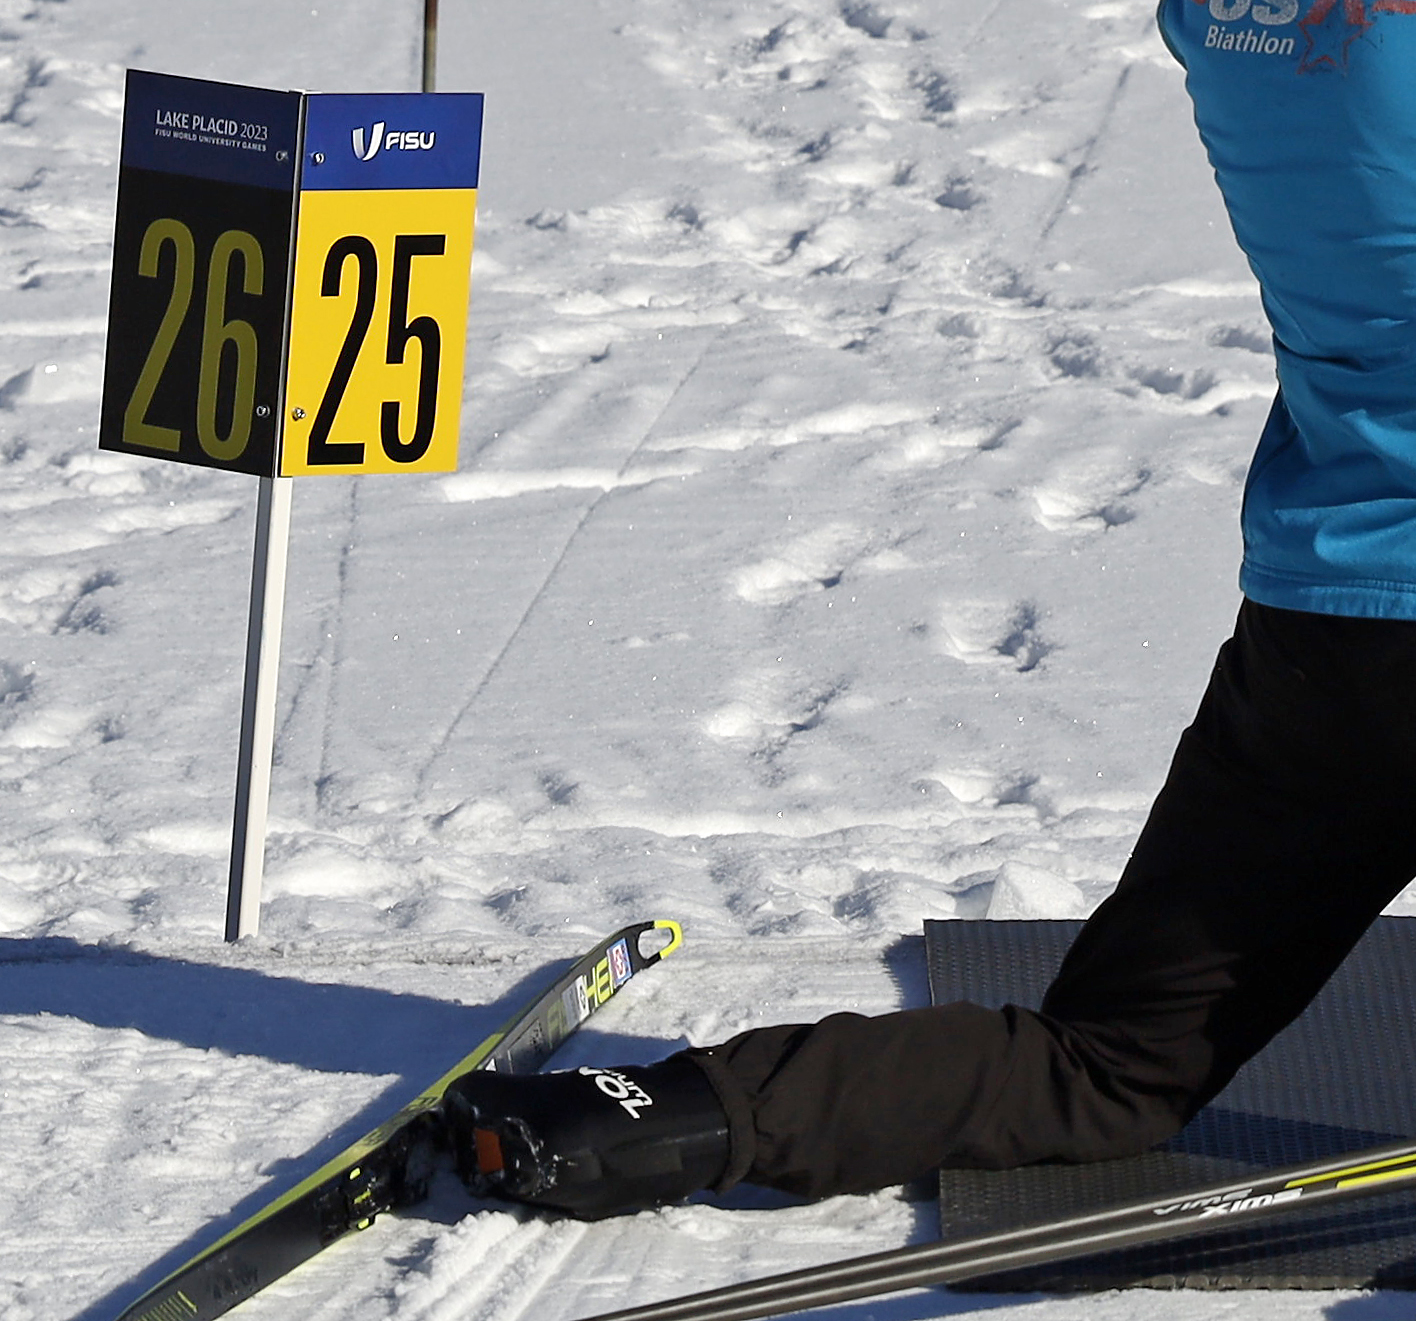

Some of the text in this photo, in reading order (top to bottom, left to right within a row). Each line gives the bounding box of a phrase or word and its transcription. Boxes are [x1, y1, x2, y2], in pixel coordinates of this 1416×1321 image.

[1204, 24, 1296, 56] Biathlon
[154, 127, 267, 153] FISU WORLD UNIVERSITY GAMES
[155, 109, 269, 141] LAKE PLACID 2023
[384, 130, 436, 151] FISU
[121, 218, 265, 462] 26
[306, 233, 447, 466] 25
